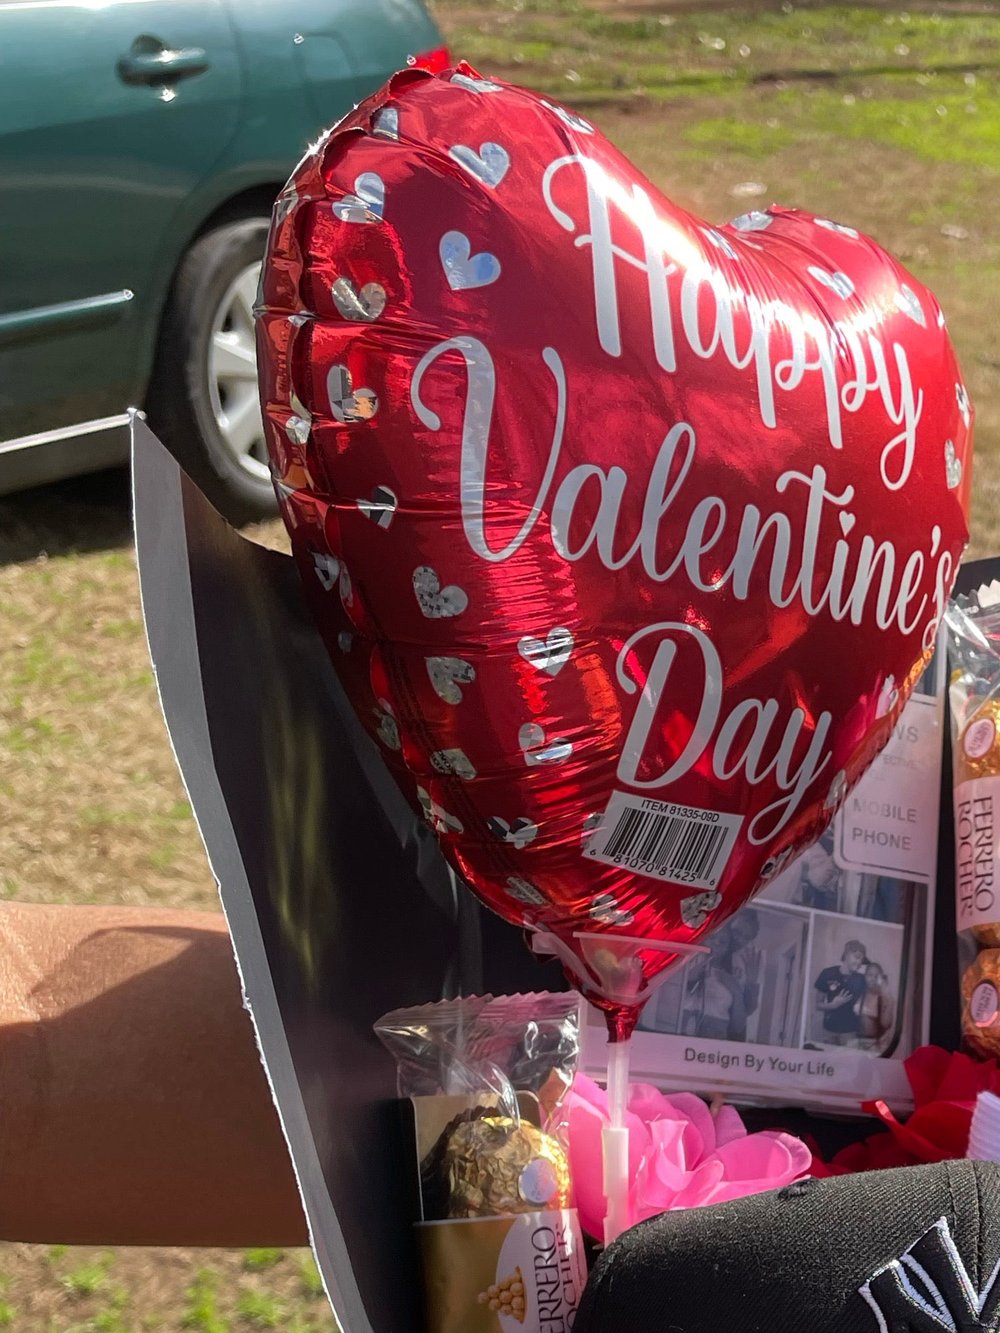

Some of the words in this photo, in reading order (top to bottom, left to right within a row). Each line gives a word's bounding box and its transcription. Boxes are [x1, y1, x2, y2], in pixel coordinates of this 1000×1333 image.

[541, 152, 923, 490] Happy
[410, 335, 953, 651] Valentine's
[615, 621, 833, 846] Day
[640, 799, 669, 813] ITEM
[670, 806, 720, 823] 81335-09D
[851, 827, 913, 852] PHONE
[852, 798, 918, 824] MOBILE
[958, 801, 974, 917] ROCHER
[973, 796, 994, 912] FERRERO
[613, 854, 655, 873] 81070
[658, 866, 697, 882] 81425
[709, 878, 716, 886] 6
[684, 1047, 739, 1069] Design
[745, 1053, 765, 1072] By
[769, 1055, 803, 1074] Your
[807, 1060, 834, 1077] Life
[557, 1226, 576, 1329] OCHER
